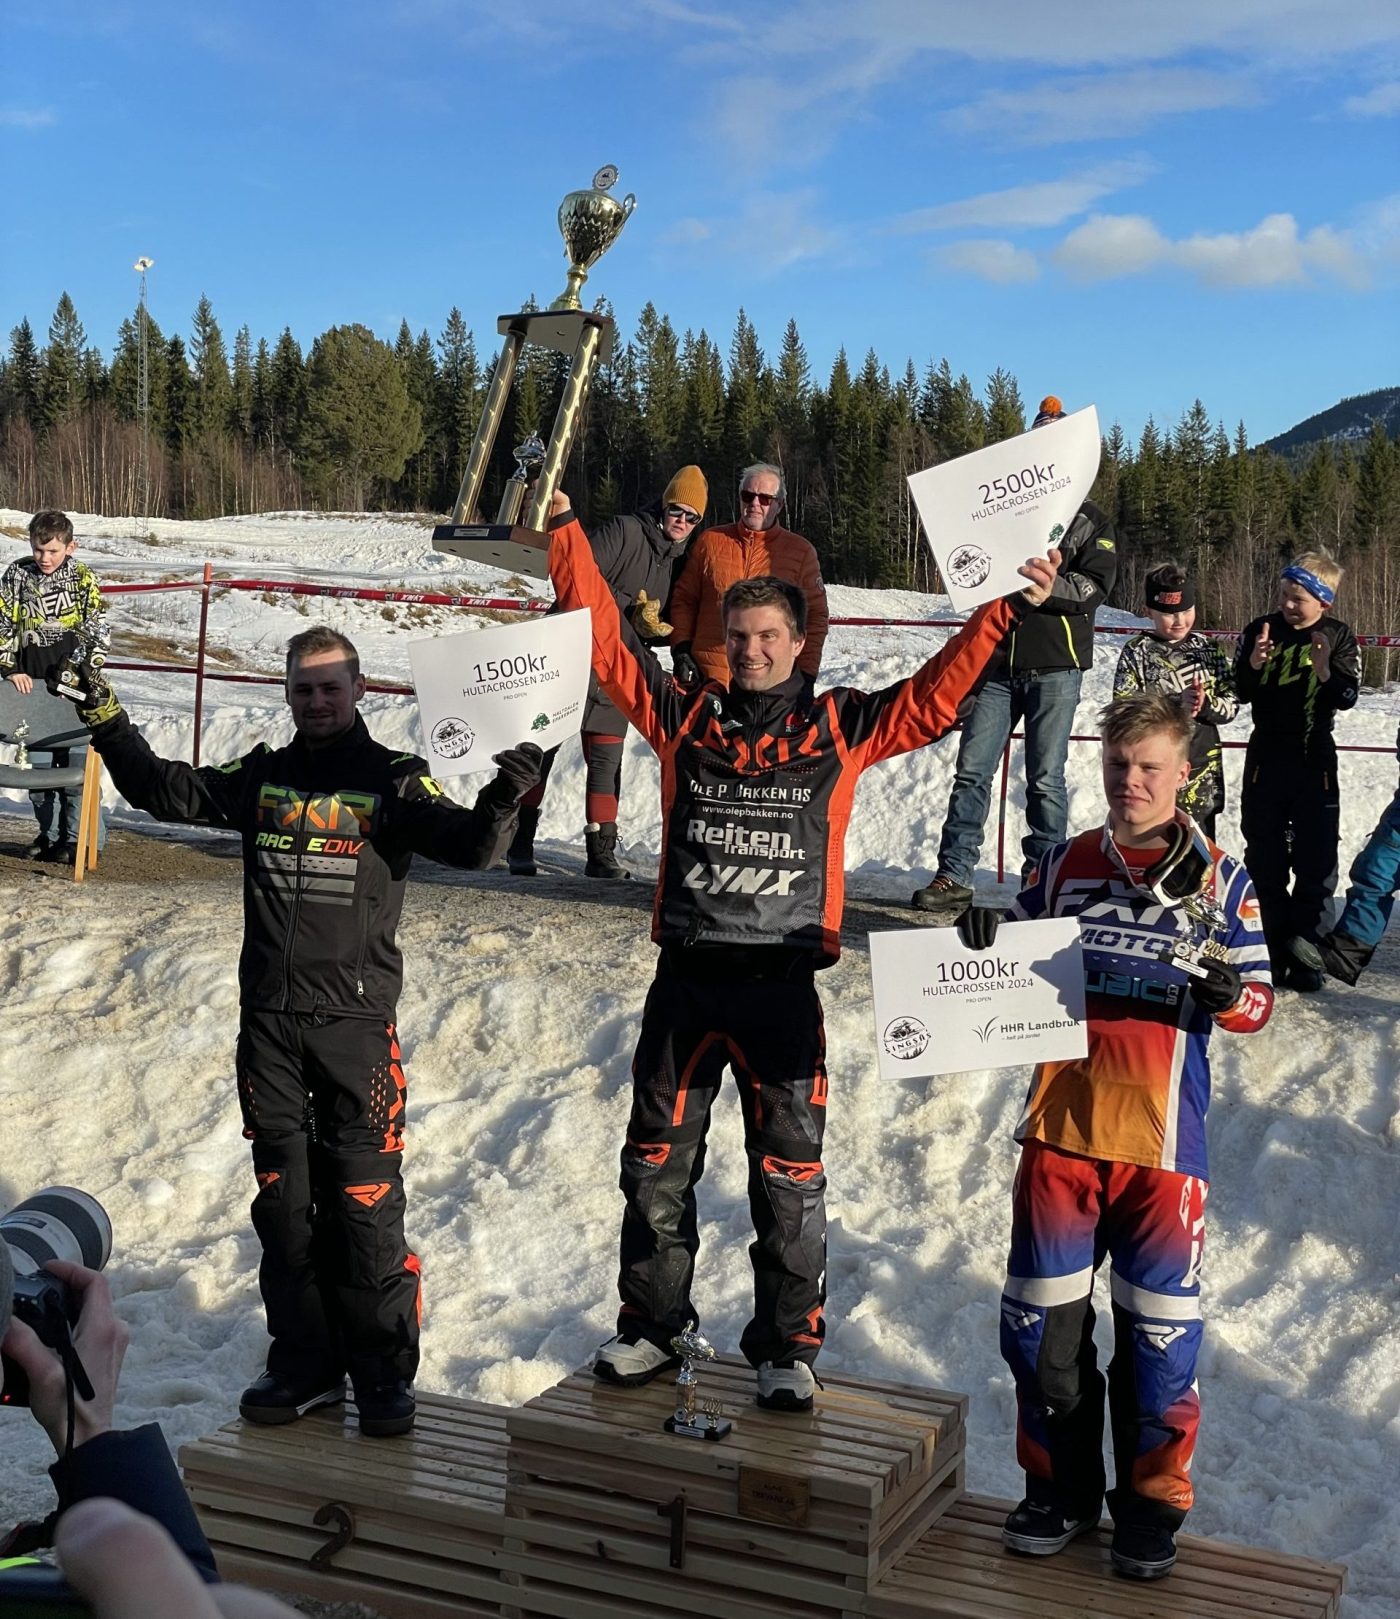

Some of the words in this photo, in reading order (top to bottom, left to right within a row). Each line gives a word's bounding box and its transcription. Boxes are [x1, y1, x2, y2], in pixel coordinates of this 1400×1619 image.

[978, 463, 1055, 504] 2500kr
[971, 486, 1048, 521] HULTACROSSEN
[1049, 475, 1072, 493] 2024
[1025, 504, 1039, 513] OPEN
[473, 653, 547, 683] 1500kr
[462, 676, 537, 697] HULTACROSSEN
[539, 669, 560, 683] 2024
[514, 691, 528, 699] OPEN
[735, 784, 787, 801] BAKKEN
[792, 788, 811, 802] AS
[702, 805, 794, 819] www.olepbakken.no
[686, 819, 791, 849] Reiten
[723, 841, 805, 860] Transport
[681, 862, 805, 896] LYNX
[937, 957, 1019, 982] 1000kr
[922, 980, 1004, 996] HULTACROSSEN
[1008, 978, 1034, 989] 2024
[1000, 1023, 1025, 1034] HHR
[1028, 1019, 1080, 1031] Landbruk
[309, 1502, 353, 1571] 2
[657, 1494, 687, 1569] 1
